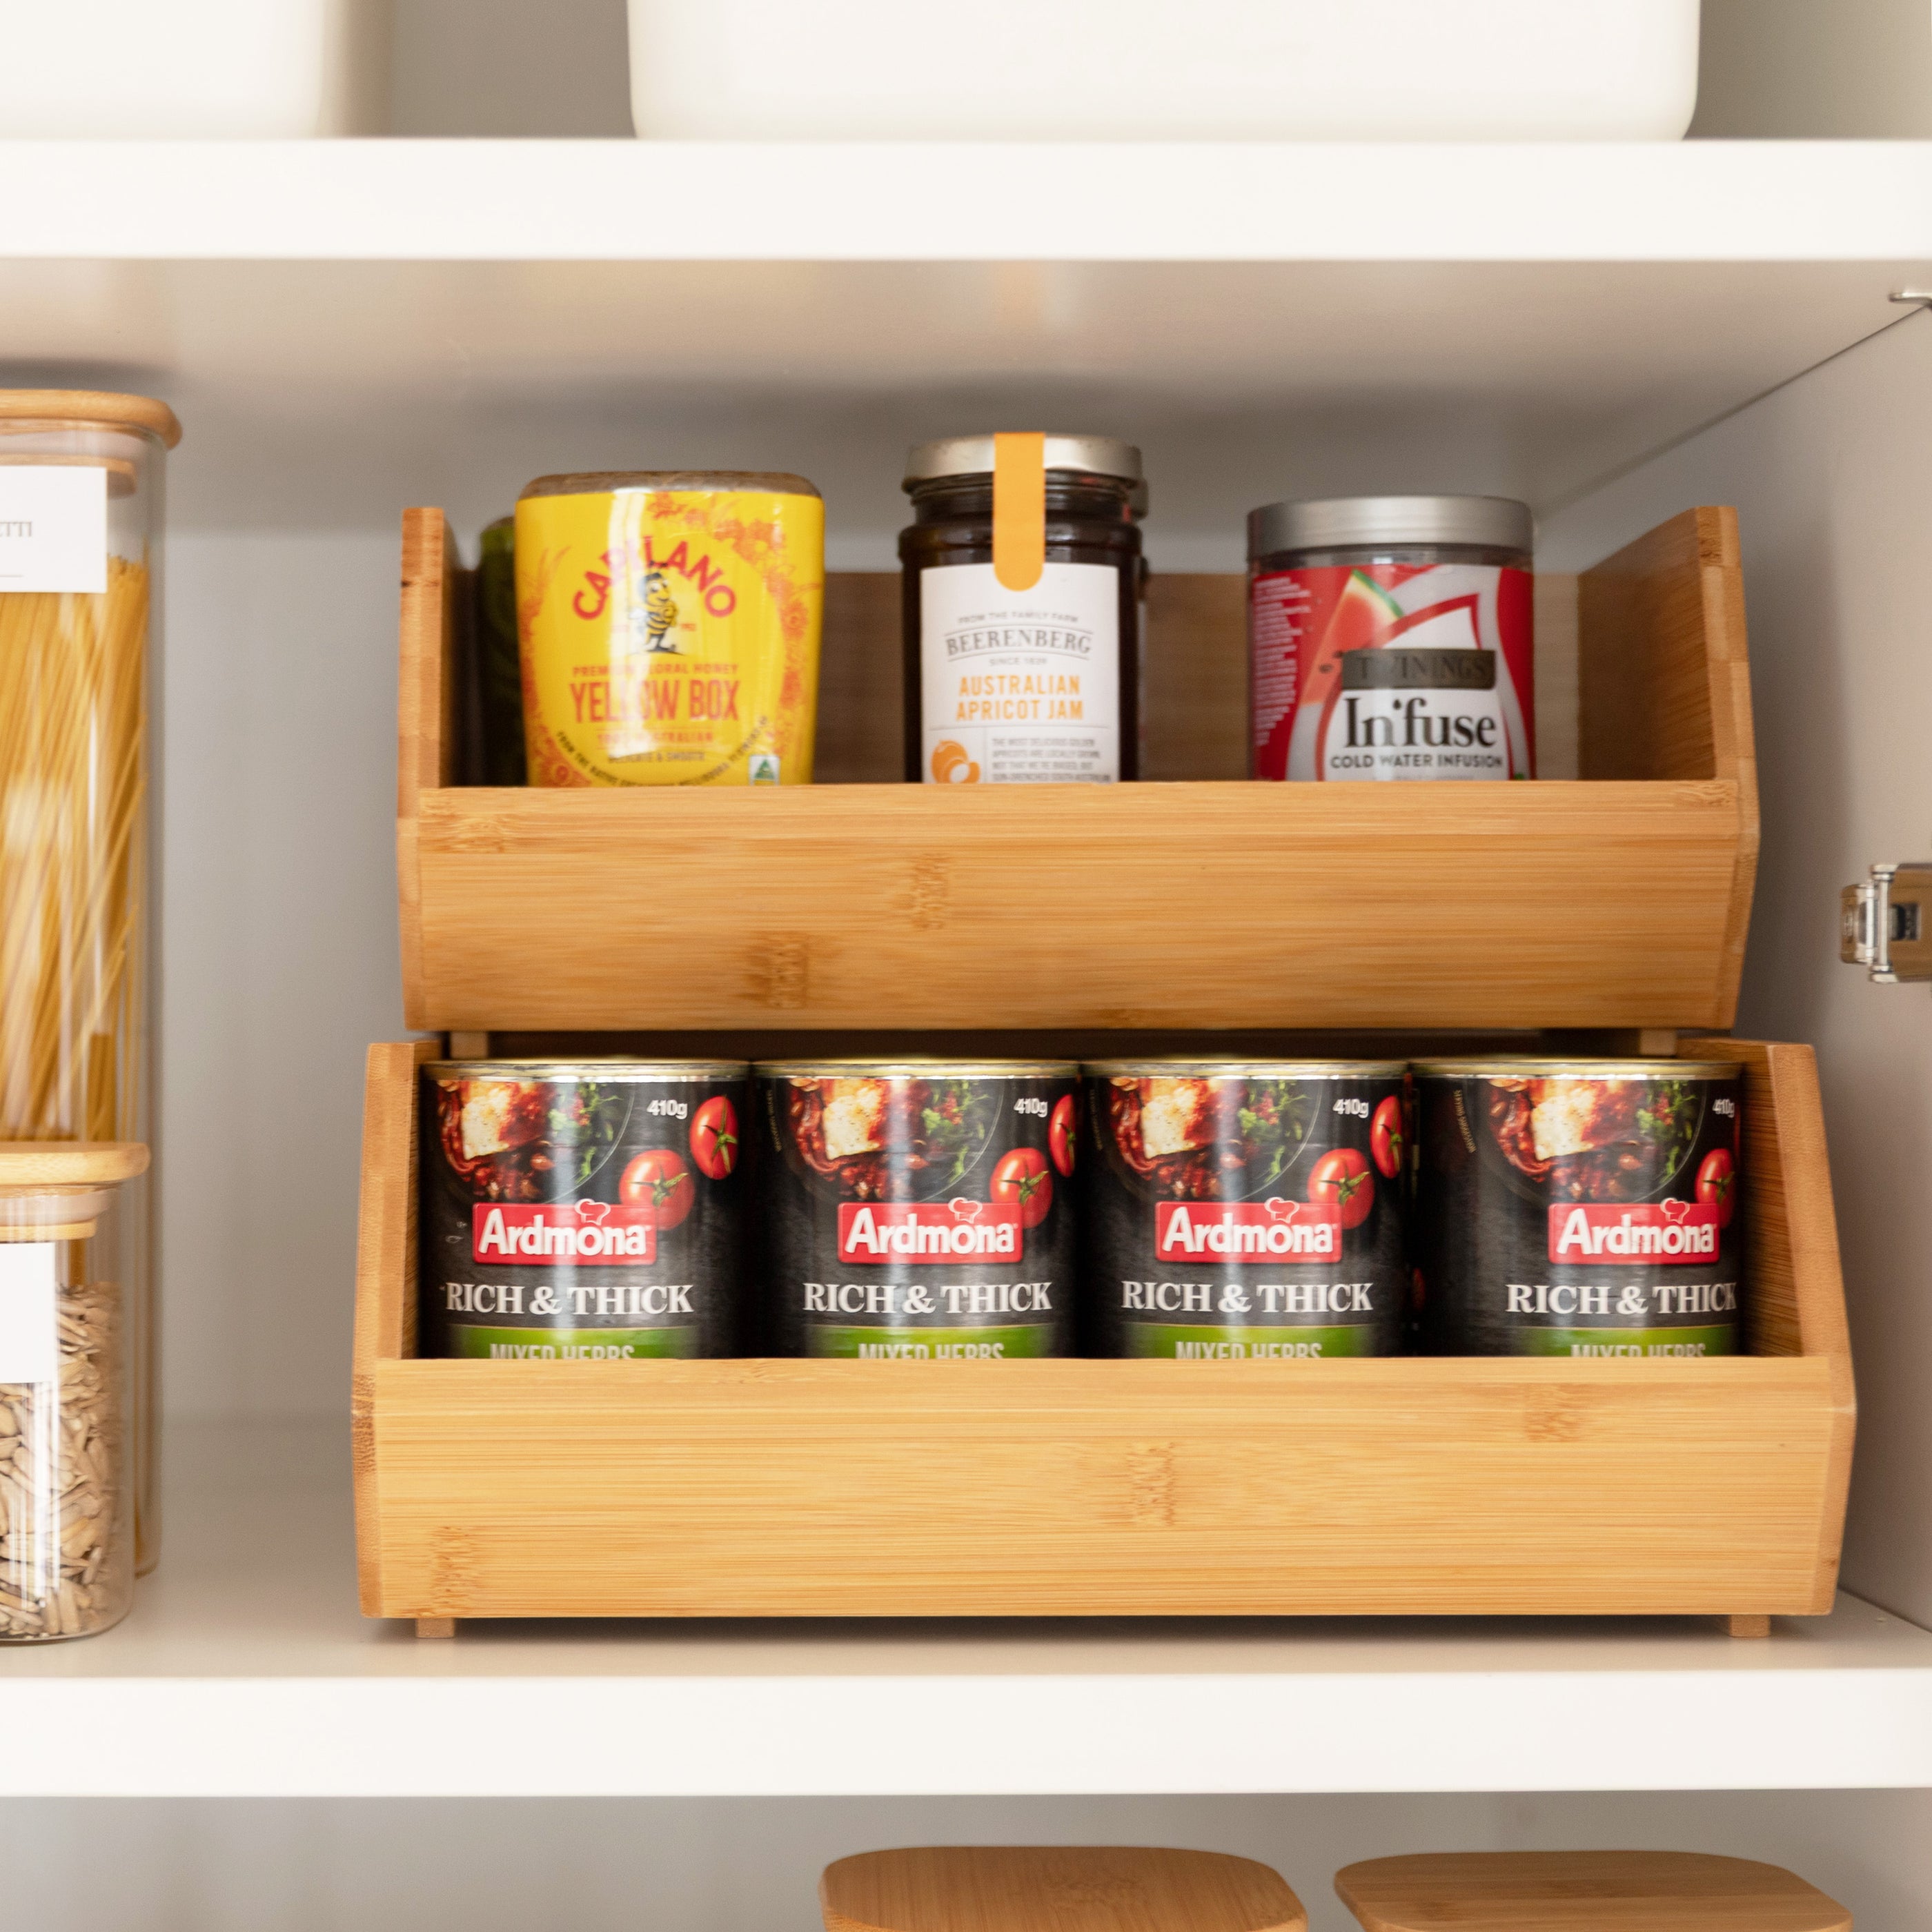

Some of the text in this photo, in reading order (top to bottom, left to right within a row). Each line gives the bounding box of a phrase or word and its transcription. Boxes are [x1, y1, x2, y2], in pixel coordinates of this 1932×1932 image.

[572, 535, 736, 620] CAPILANO
[945, 629, 1092, 656] BEERENBERG
[573, 664, 635, 677] PREMM
[989, 658, 1021, 667] SINCE
[958, 674, 1081, 697] AUSTRALIAN
[570, 679, 740, 723] YELLOW BOX
[956, 699, 1085, 721] APRICOT JAM
[1330, 754, 1503, 769] COLD WATER INFUSION
[647, 1099, 687, 1119] 410g
[1014, 1098, 1047, 1117] 410g
[1332, 1098, 1369, 1118] 410g
[1712, 1098, 1735, 1118] 410g
[478, 1208, 647, 1256] Ardmona
[845, 1207, 1015, 1254] Ardmona
[1161, 1206, 1333, 1254] Ardmona
[1556, 1208, 1715, 1254] Ardmona
[446, 1282, 694, 1315] RICH & THICK
[802, 1282, 1053, 1314] RICH & THICK
[1121, 1280, 1374, 1313] RICH & THICK
[1505, 1282, 1737, 1315] RICH & THICK
